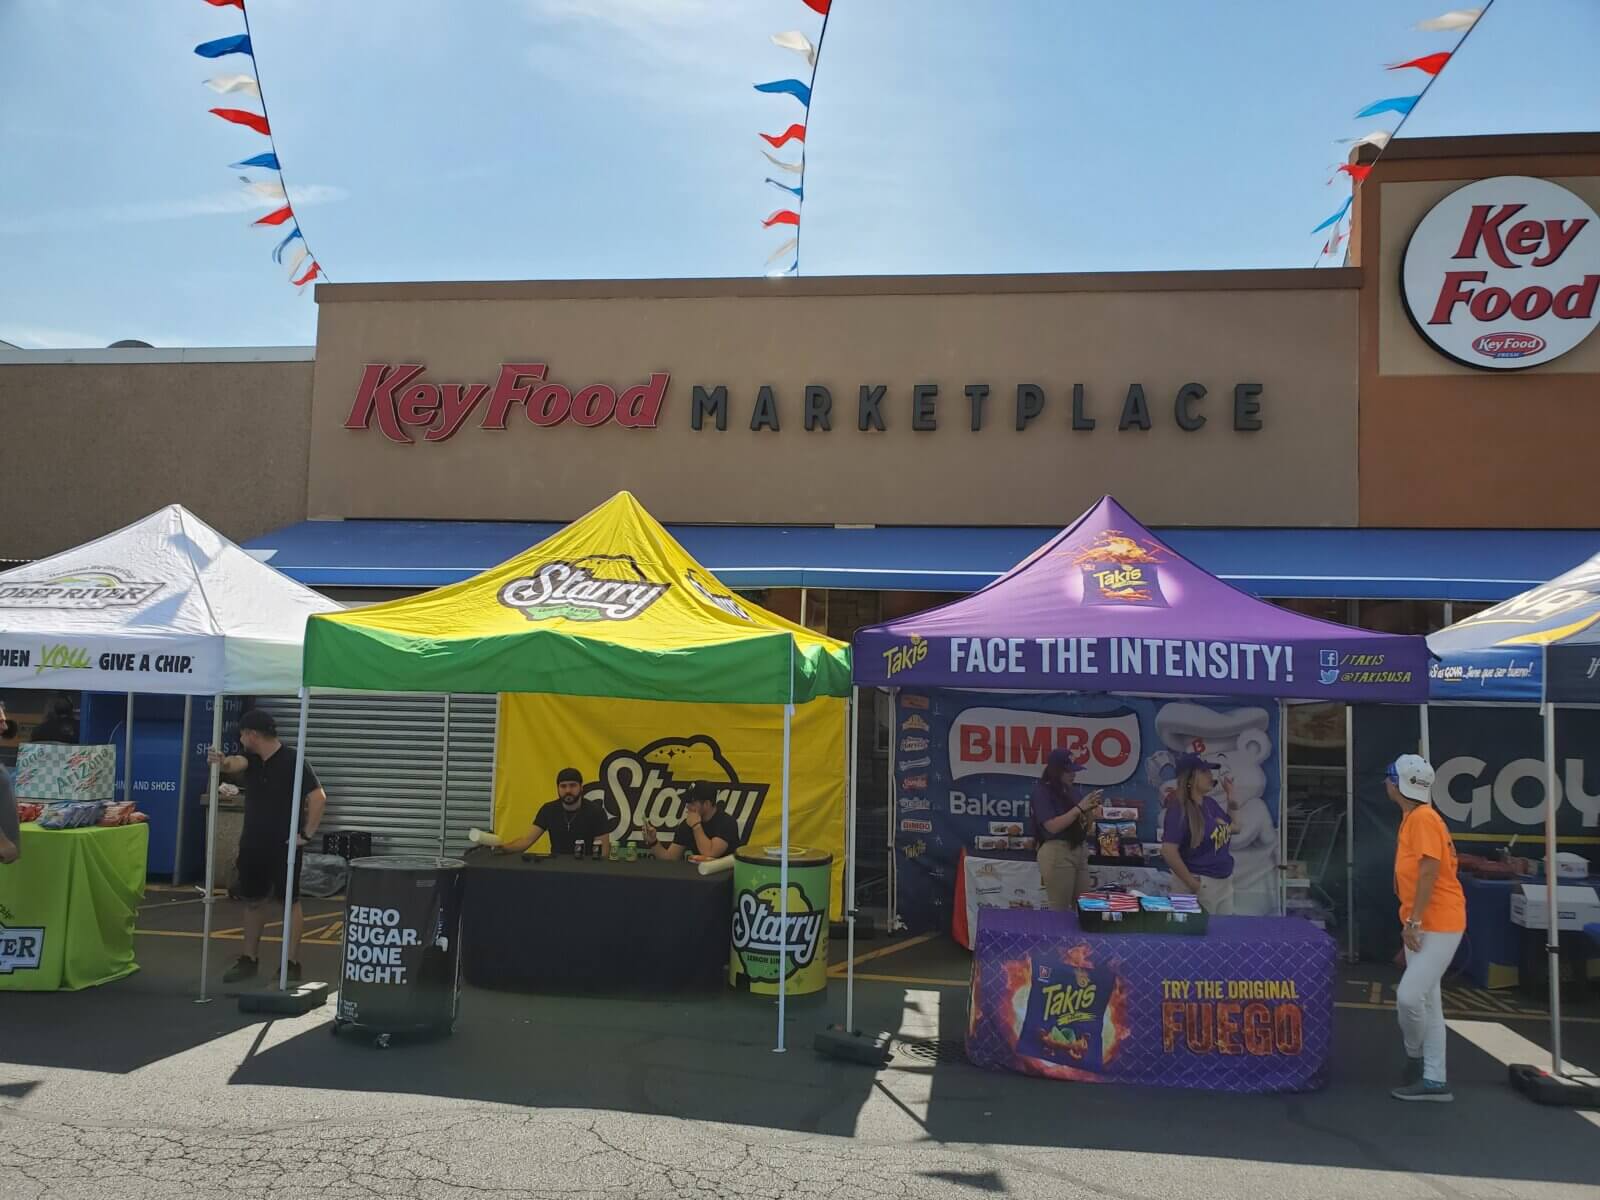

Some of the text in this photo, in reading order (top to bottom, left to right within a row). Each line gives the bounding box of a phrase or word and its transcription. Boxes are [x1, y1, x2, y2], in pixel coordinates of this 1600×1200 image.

[1451, 203, 1590, 269] Key
[1427, 271, 1600, 325] Food
[690, 382, 1264, 432] MARKETPLACE
[0, 587, 146, 599] DEEP RIVER
[502, 562, 662, 620] Starry
[1093, 565, 1142, 588] Takis
[0, 649, 30, 667] HEN
[99, 653, 135, 671] GIVE
[139, 654, 150, 672] A
[882, 638, 928, 679] Takis
[949, 636, 1294, 682] FACE THE INTENSITY!
[1340, 671, 1412, 683] @TAKISUSA
[959, 724, 1131, 768] BIMBO
[133, 780, 149, 791] AND
[151, 781, 176, 791] SHOES
[584, 757, 758, 842] Stay
[1431, 756, 1600, 829] GOY
[949, 790, 1032, 818] Bakeri
[350, 905, 400, 927] ZERO
[732, 893, 821, 964] Starry
[0, 936, 35, 957] ER
[348, 924, 422, 946] SUGAR.
[347, 943, 402, 965] DONE
[345, 962, 407, 985] RIGHT.
[1162, 979, 1299, 1000] TRY THE ORIGINAL
[1042, 983, 1097, 1021] Takis
[1161, 1001, 1303, 1056] FUEGO
